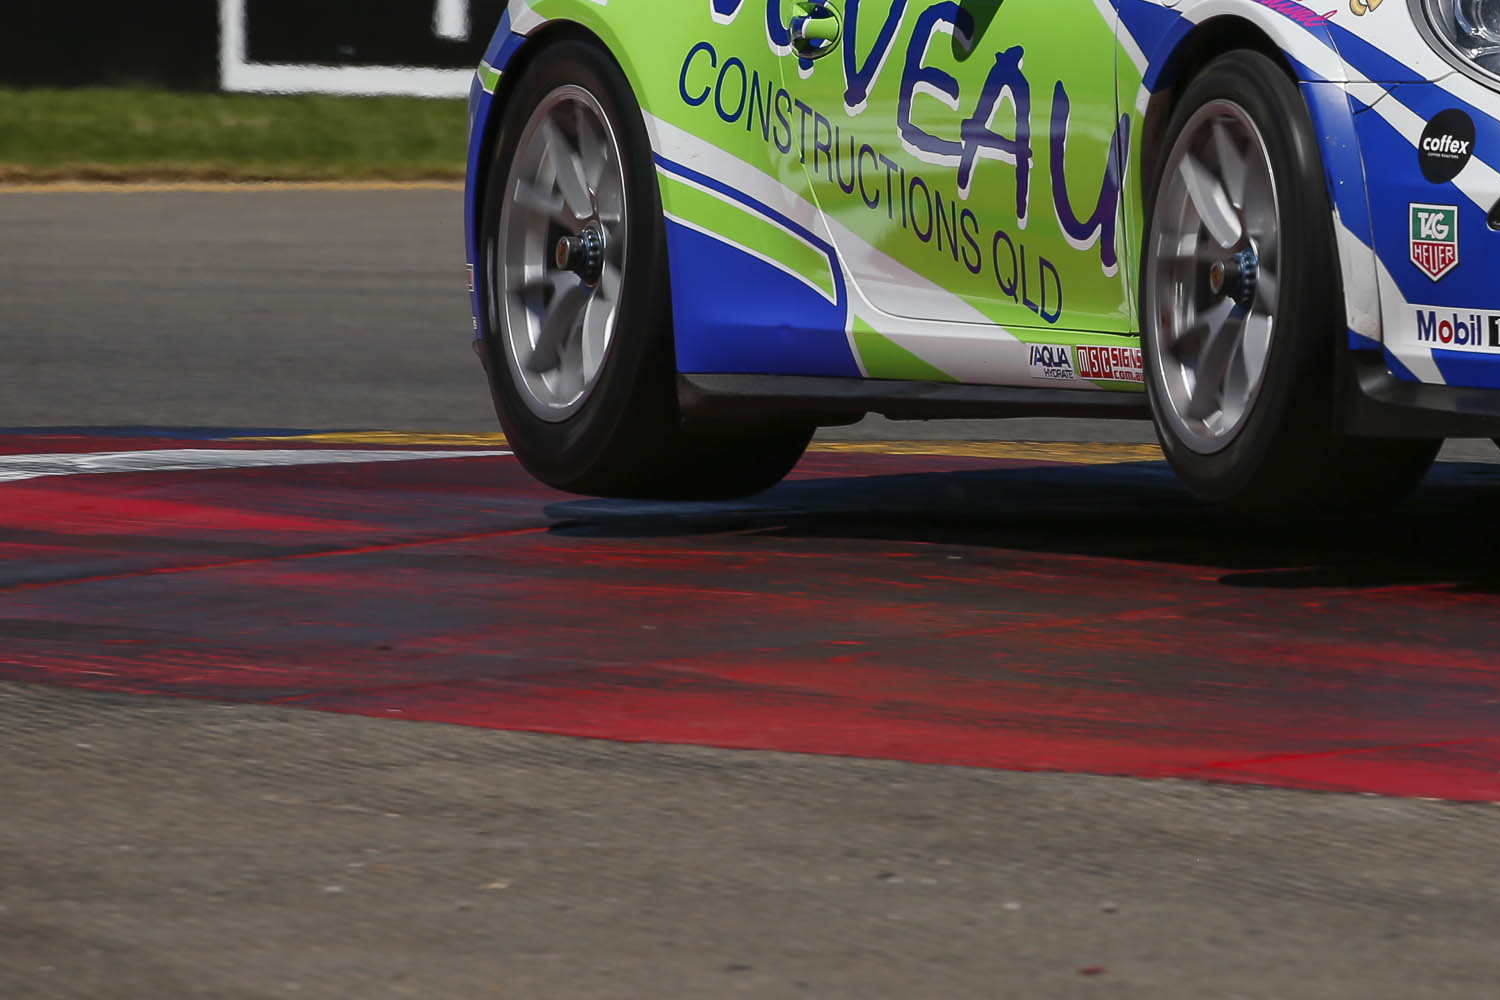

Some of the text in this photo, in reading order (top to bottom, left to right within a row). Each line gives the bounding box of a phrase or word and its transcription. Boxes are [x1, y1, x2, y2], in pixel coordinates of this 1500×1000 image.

[1423, 134, 1470, 155] coffex
[678, 41, 1063, 324] CONSTRUCTIONS QLD
[1417, 211, 1450, 240] TAG
[1413, 244, 1455, 274] HEUER
[1416, 310, 1482, 346] Mobil
